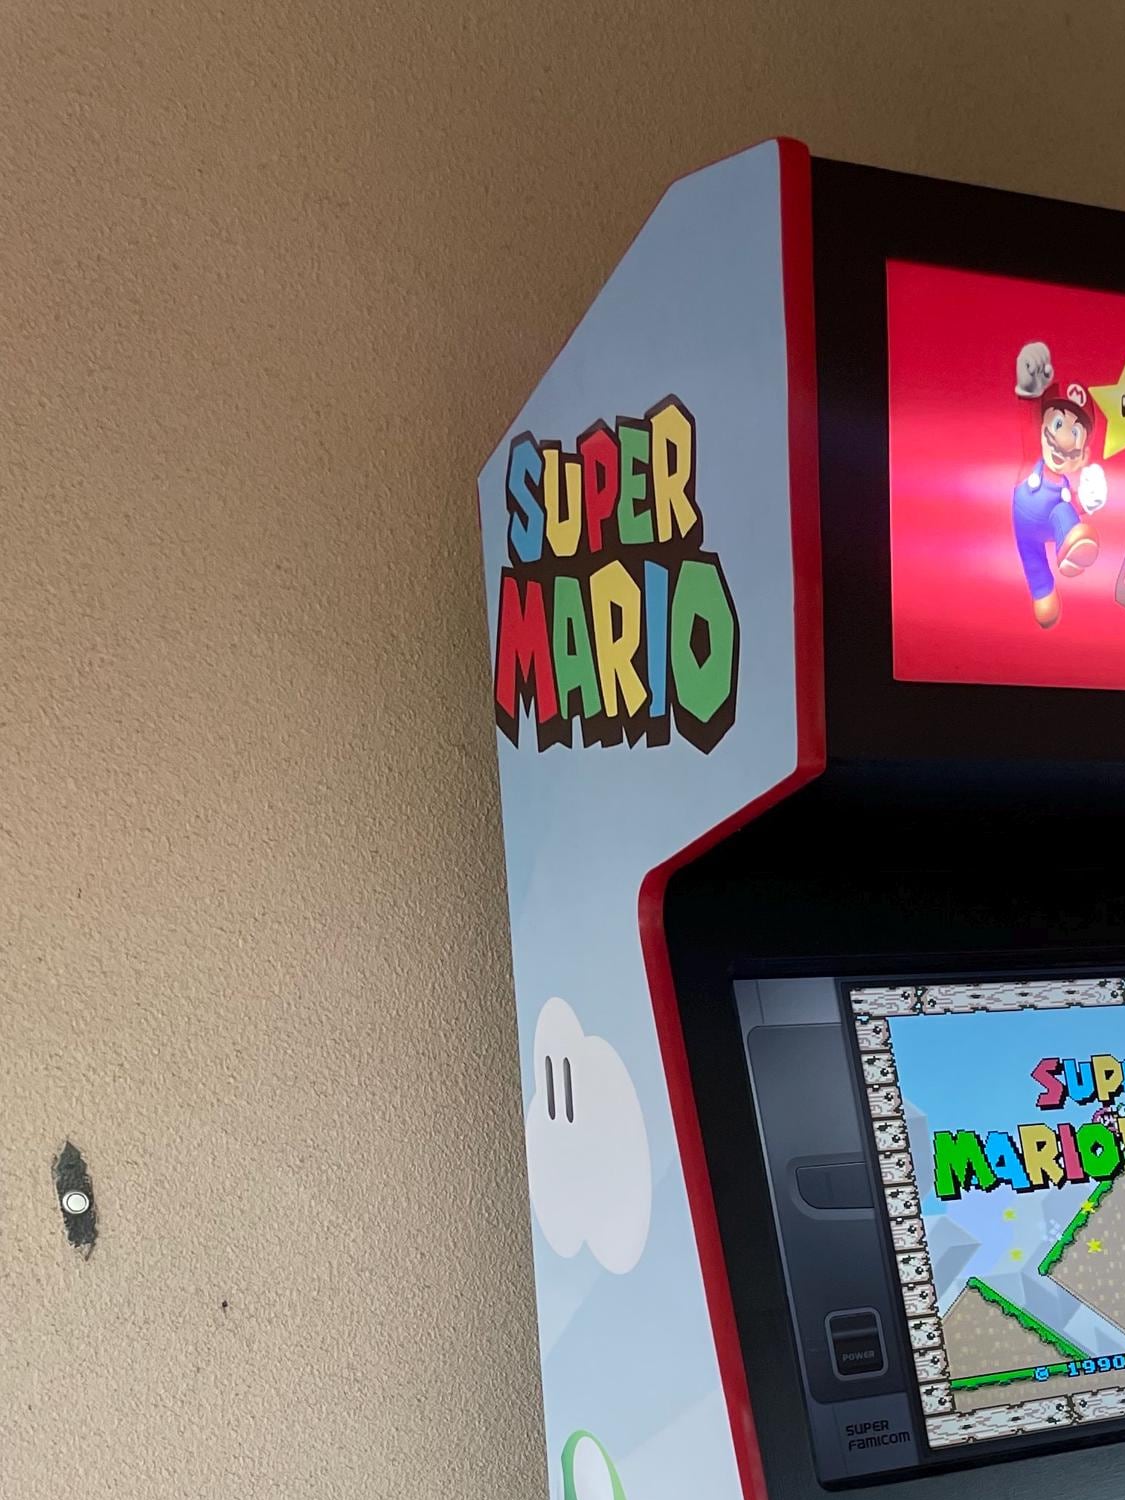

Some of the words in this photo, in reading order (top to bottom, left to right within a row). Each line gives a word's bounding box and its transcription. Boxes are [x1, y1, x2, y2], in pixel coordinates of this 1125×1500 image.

[505, 402, 699, 564] SUPER
[495, 558, 736, 728] MARIO
[933, 1122, 1125, 1200] MARIO
[842, 1350, 875, 1361] POWER
[845, 1420, 889, 1437] SUPER
